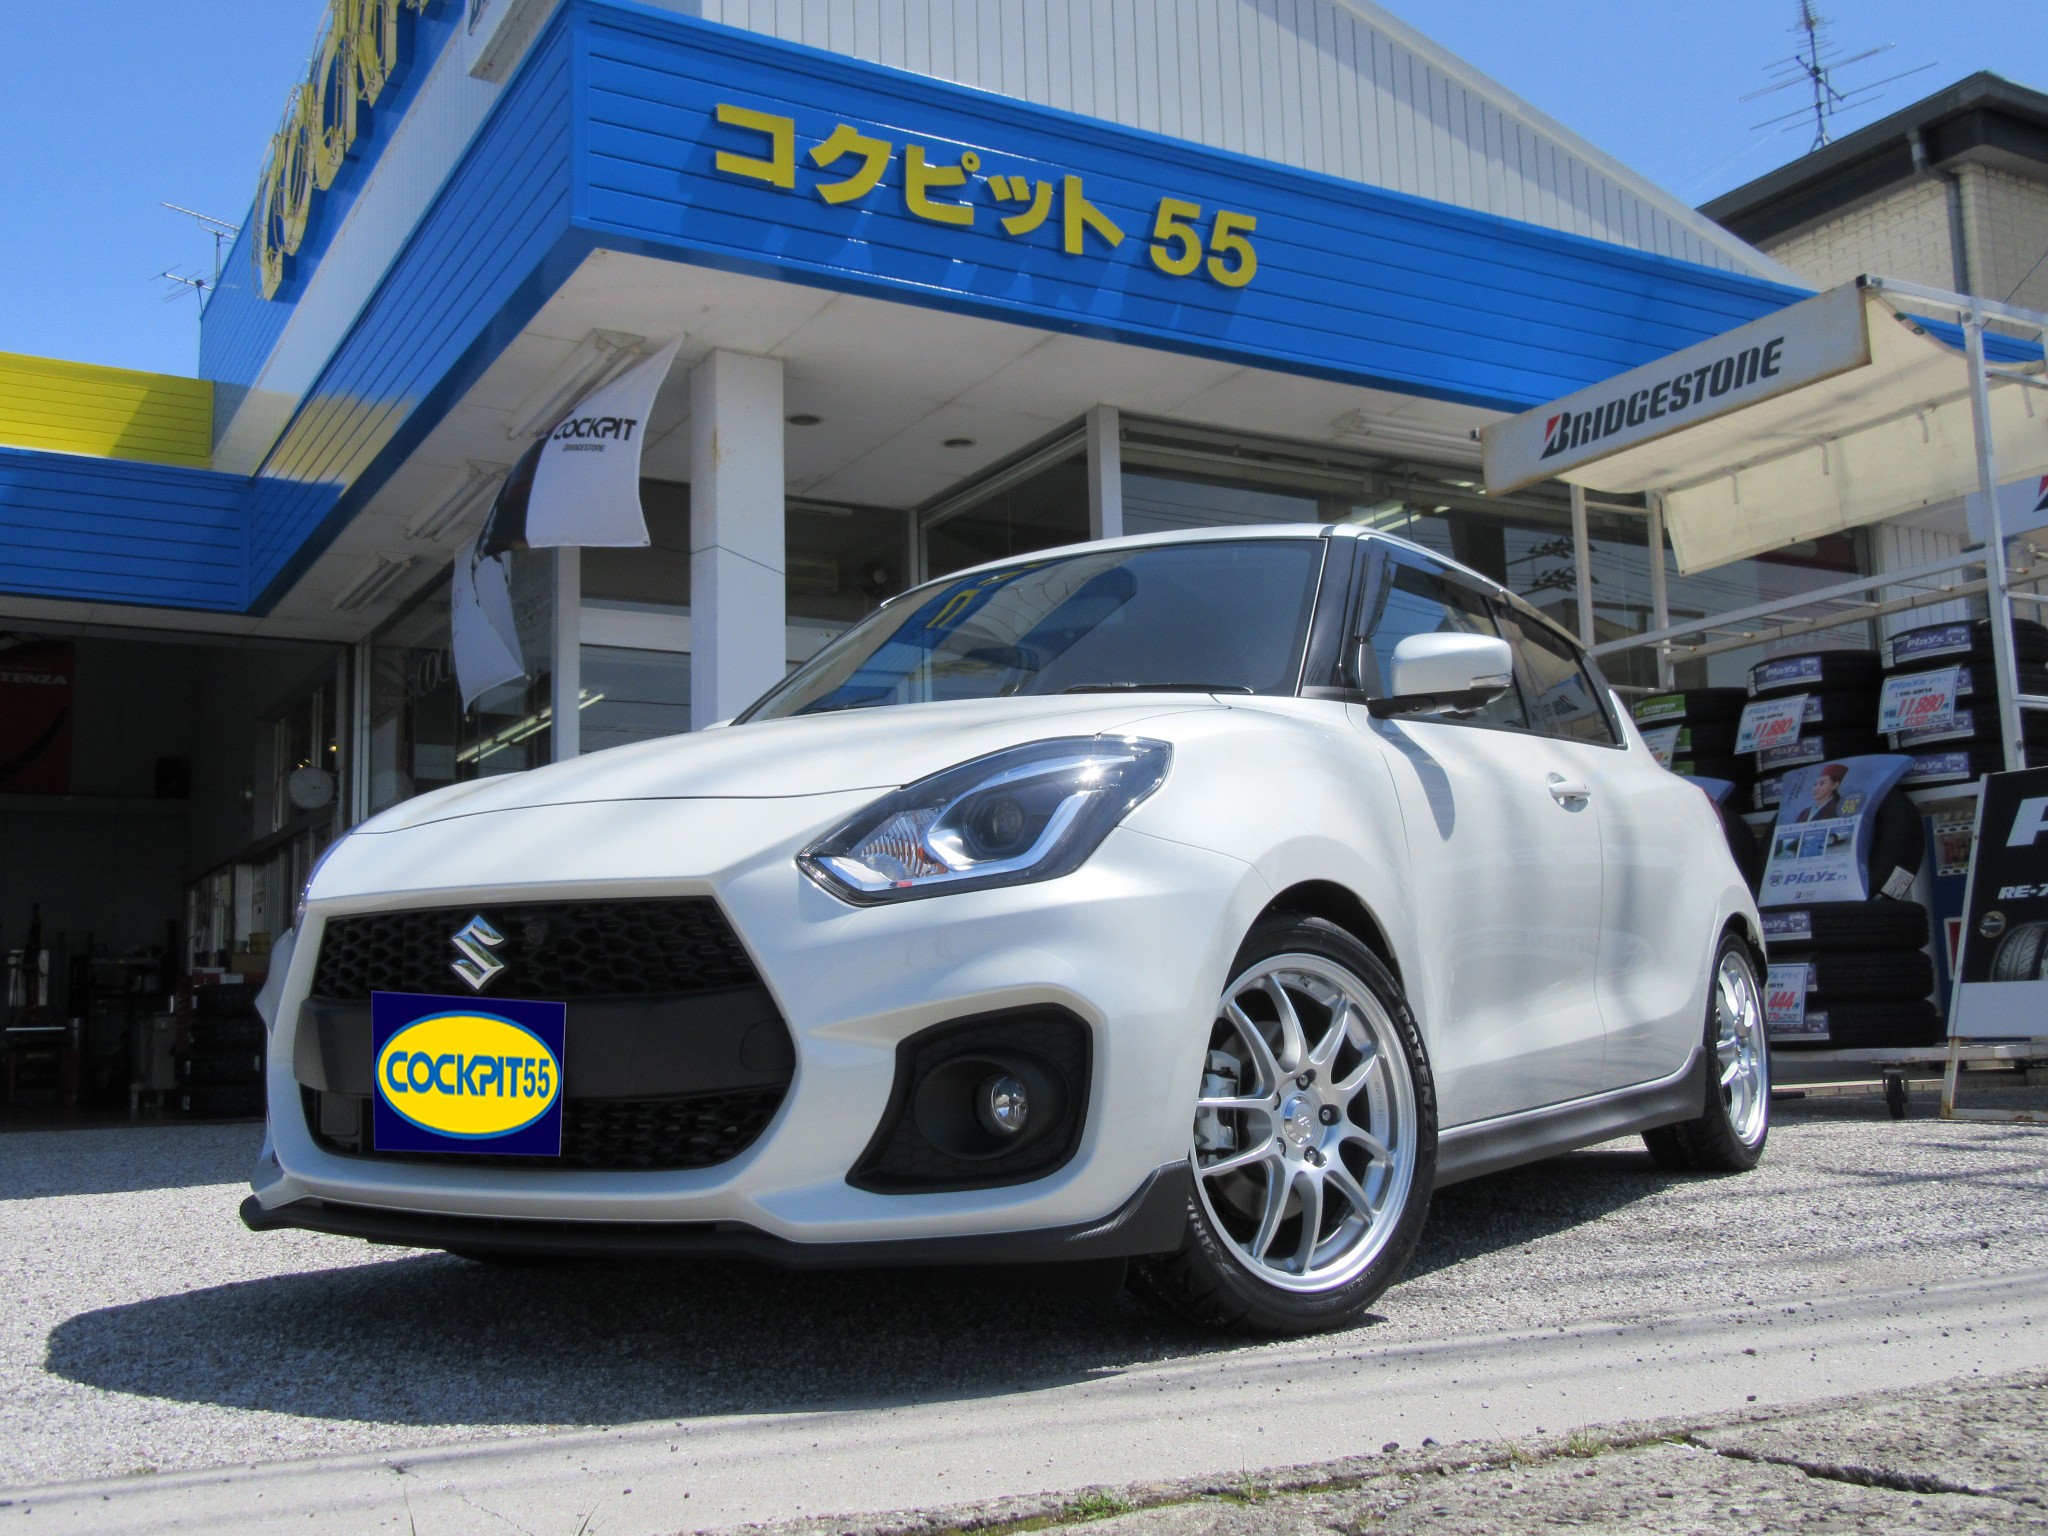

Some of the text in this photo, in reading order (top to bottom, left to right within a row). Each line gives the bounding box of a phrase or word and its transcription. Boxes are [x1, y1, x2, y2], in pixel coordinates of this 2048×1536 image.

[715, 103, 1258, 287] コクピット 55
[553, 416, 637, 441] COCKPIT
[1539, 336, 1785, 460] BRIDGESTONE
[1783, 870, 1838, 885] Playz
